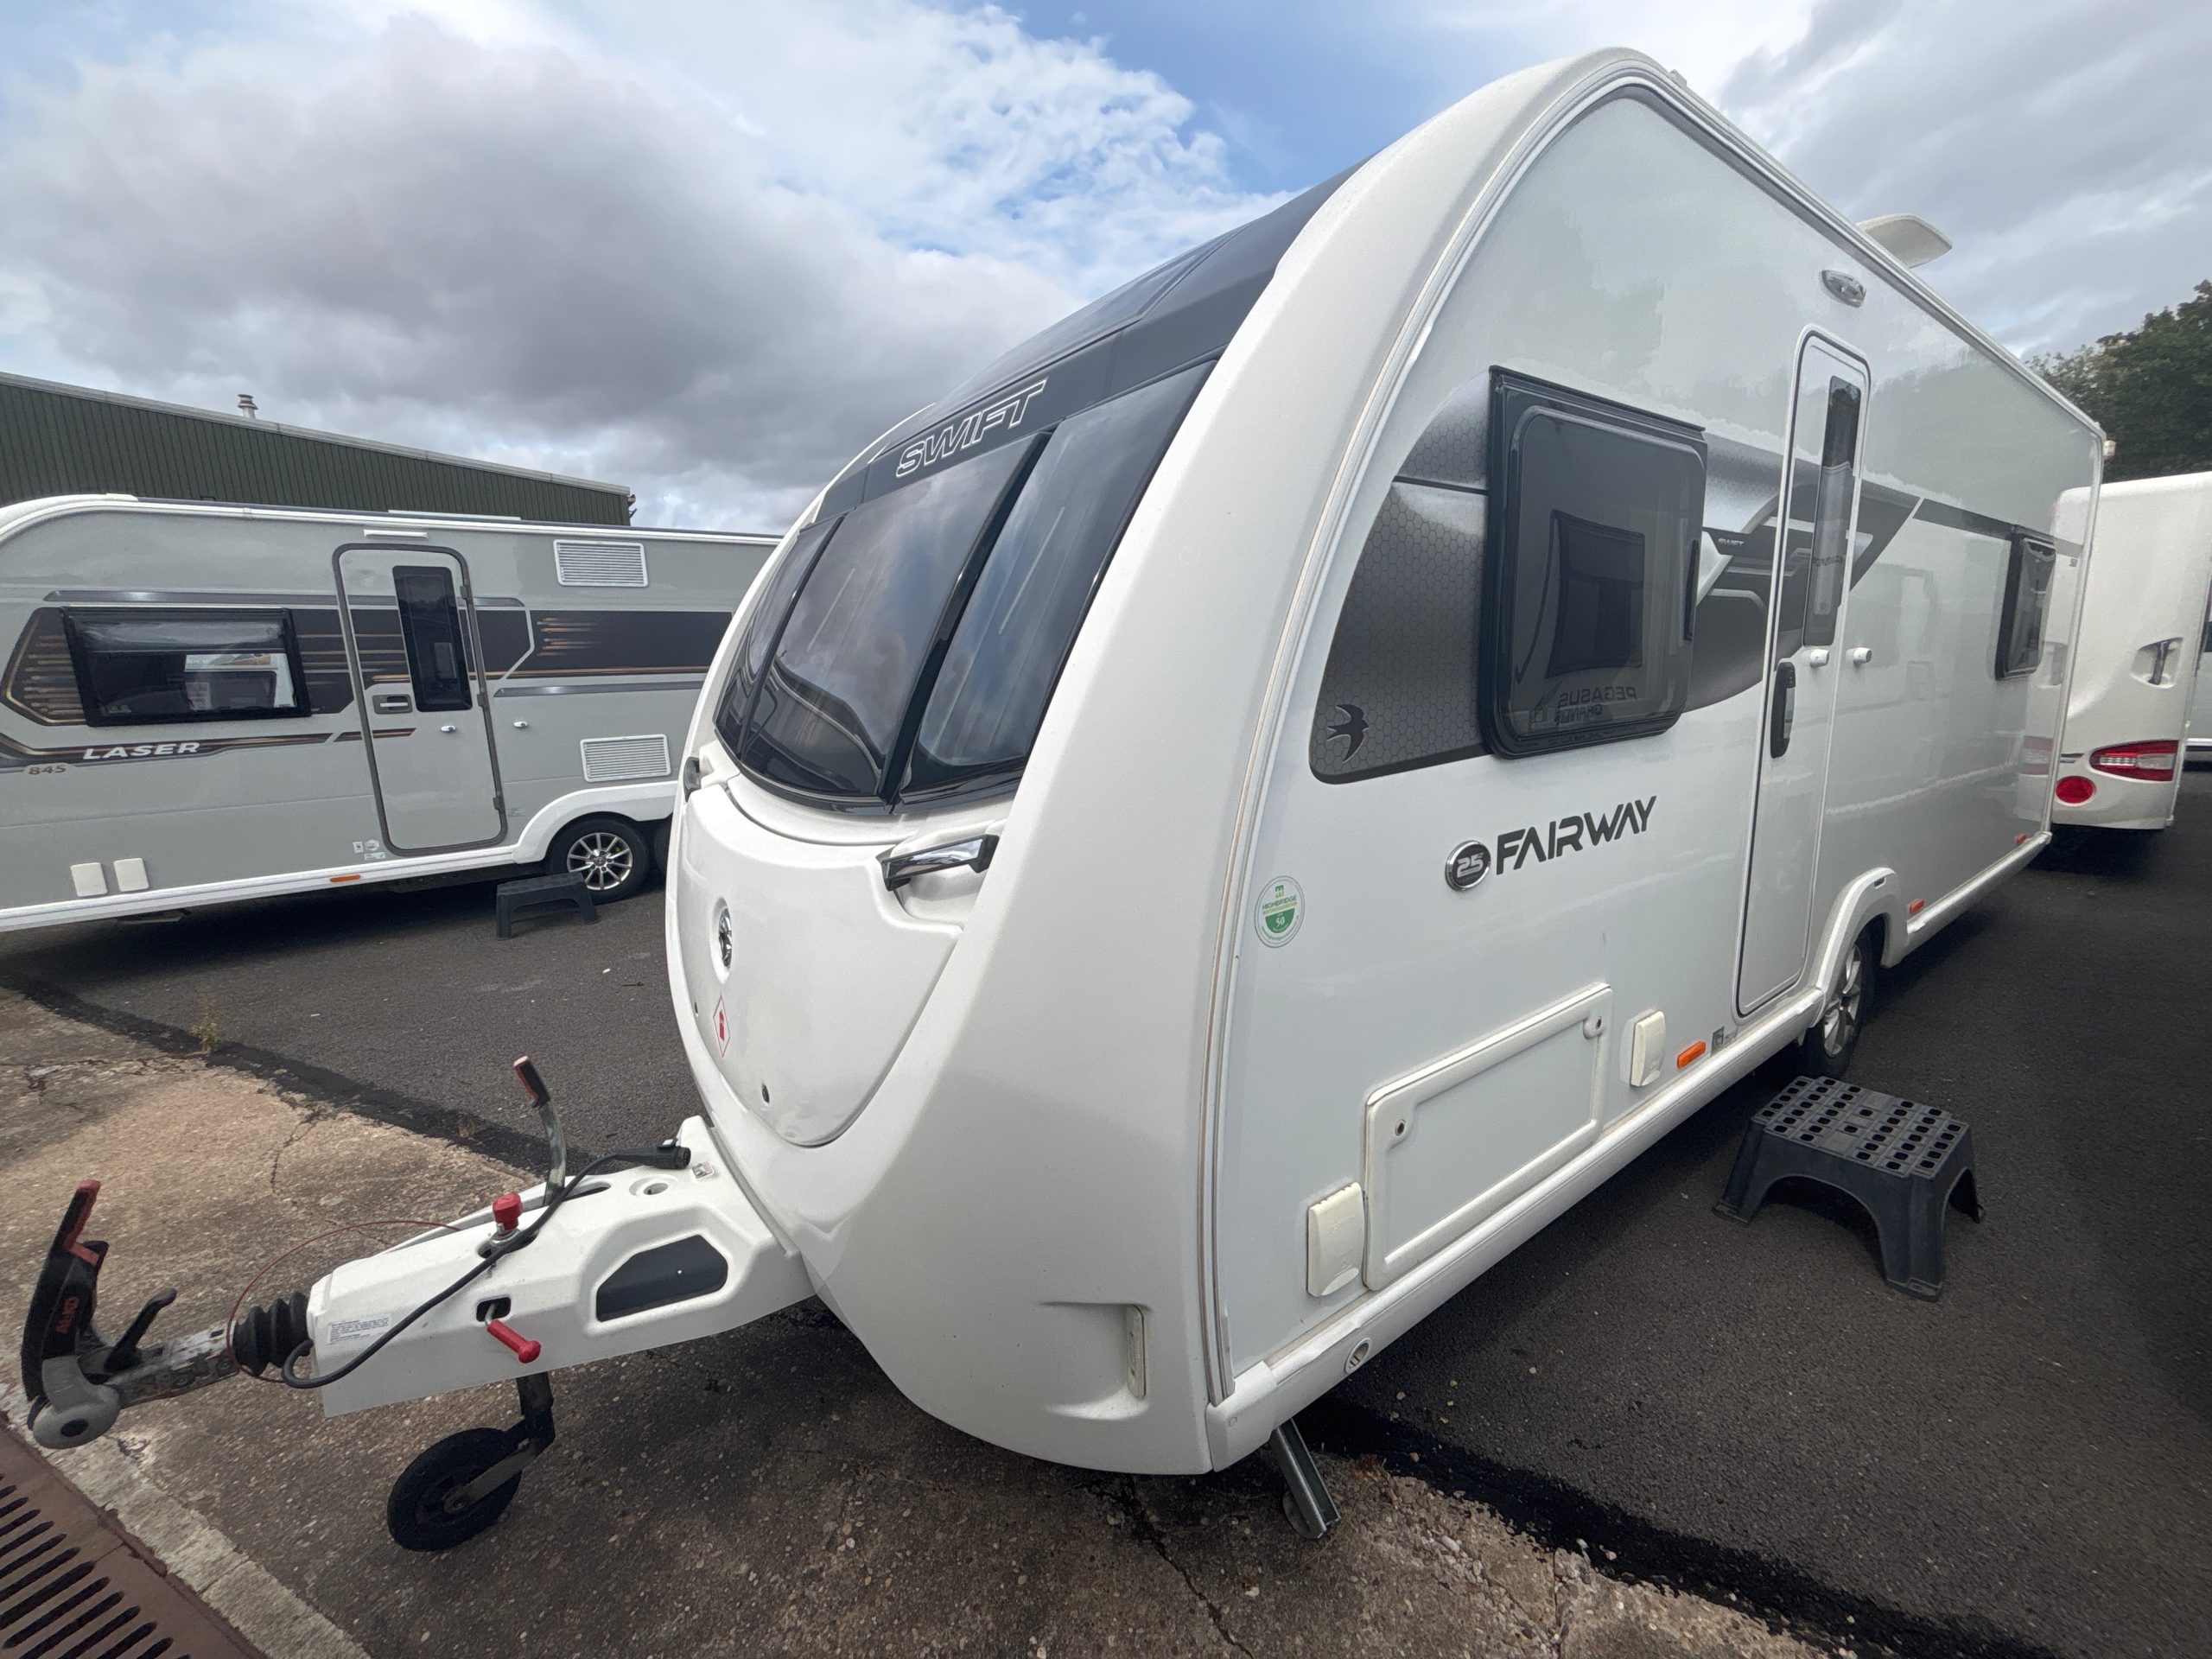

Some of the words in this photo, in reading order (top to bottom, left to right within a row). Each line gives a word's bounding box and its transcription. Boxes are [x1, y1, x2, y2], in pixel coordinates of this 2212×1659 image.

[896, 377, 1049, 477] SWIFT
[1718, 537, 1745, 546] SWIFT
[82, 742, 200, 760] LASER
[29, 765, 67, 775] 845
[1496, 796, 1657, 875] FAIRWAY
[1457, 852, 1484, 879] 25
[1275, 916, 1285, 927] 50
